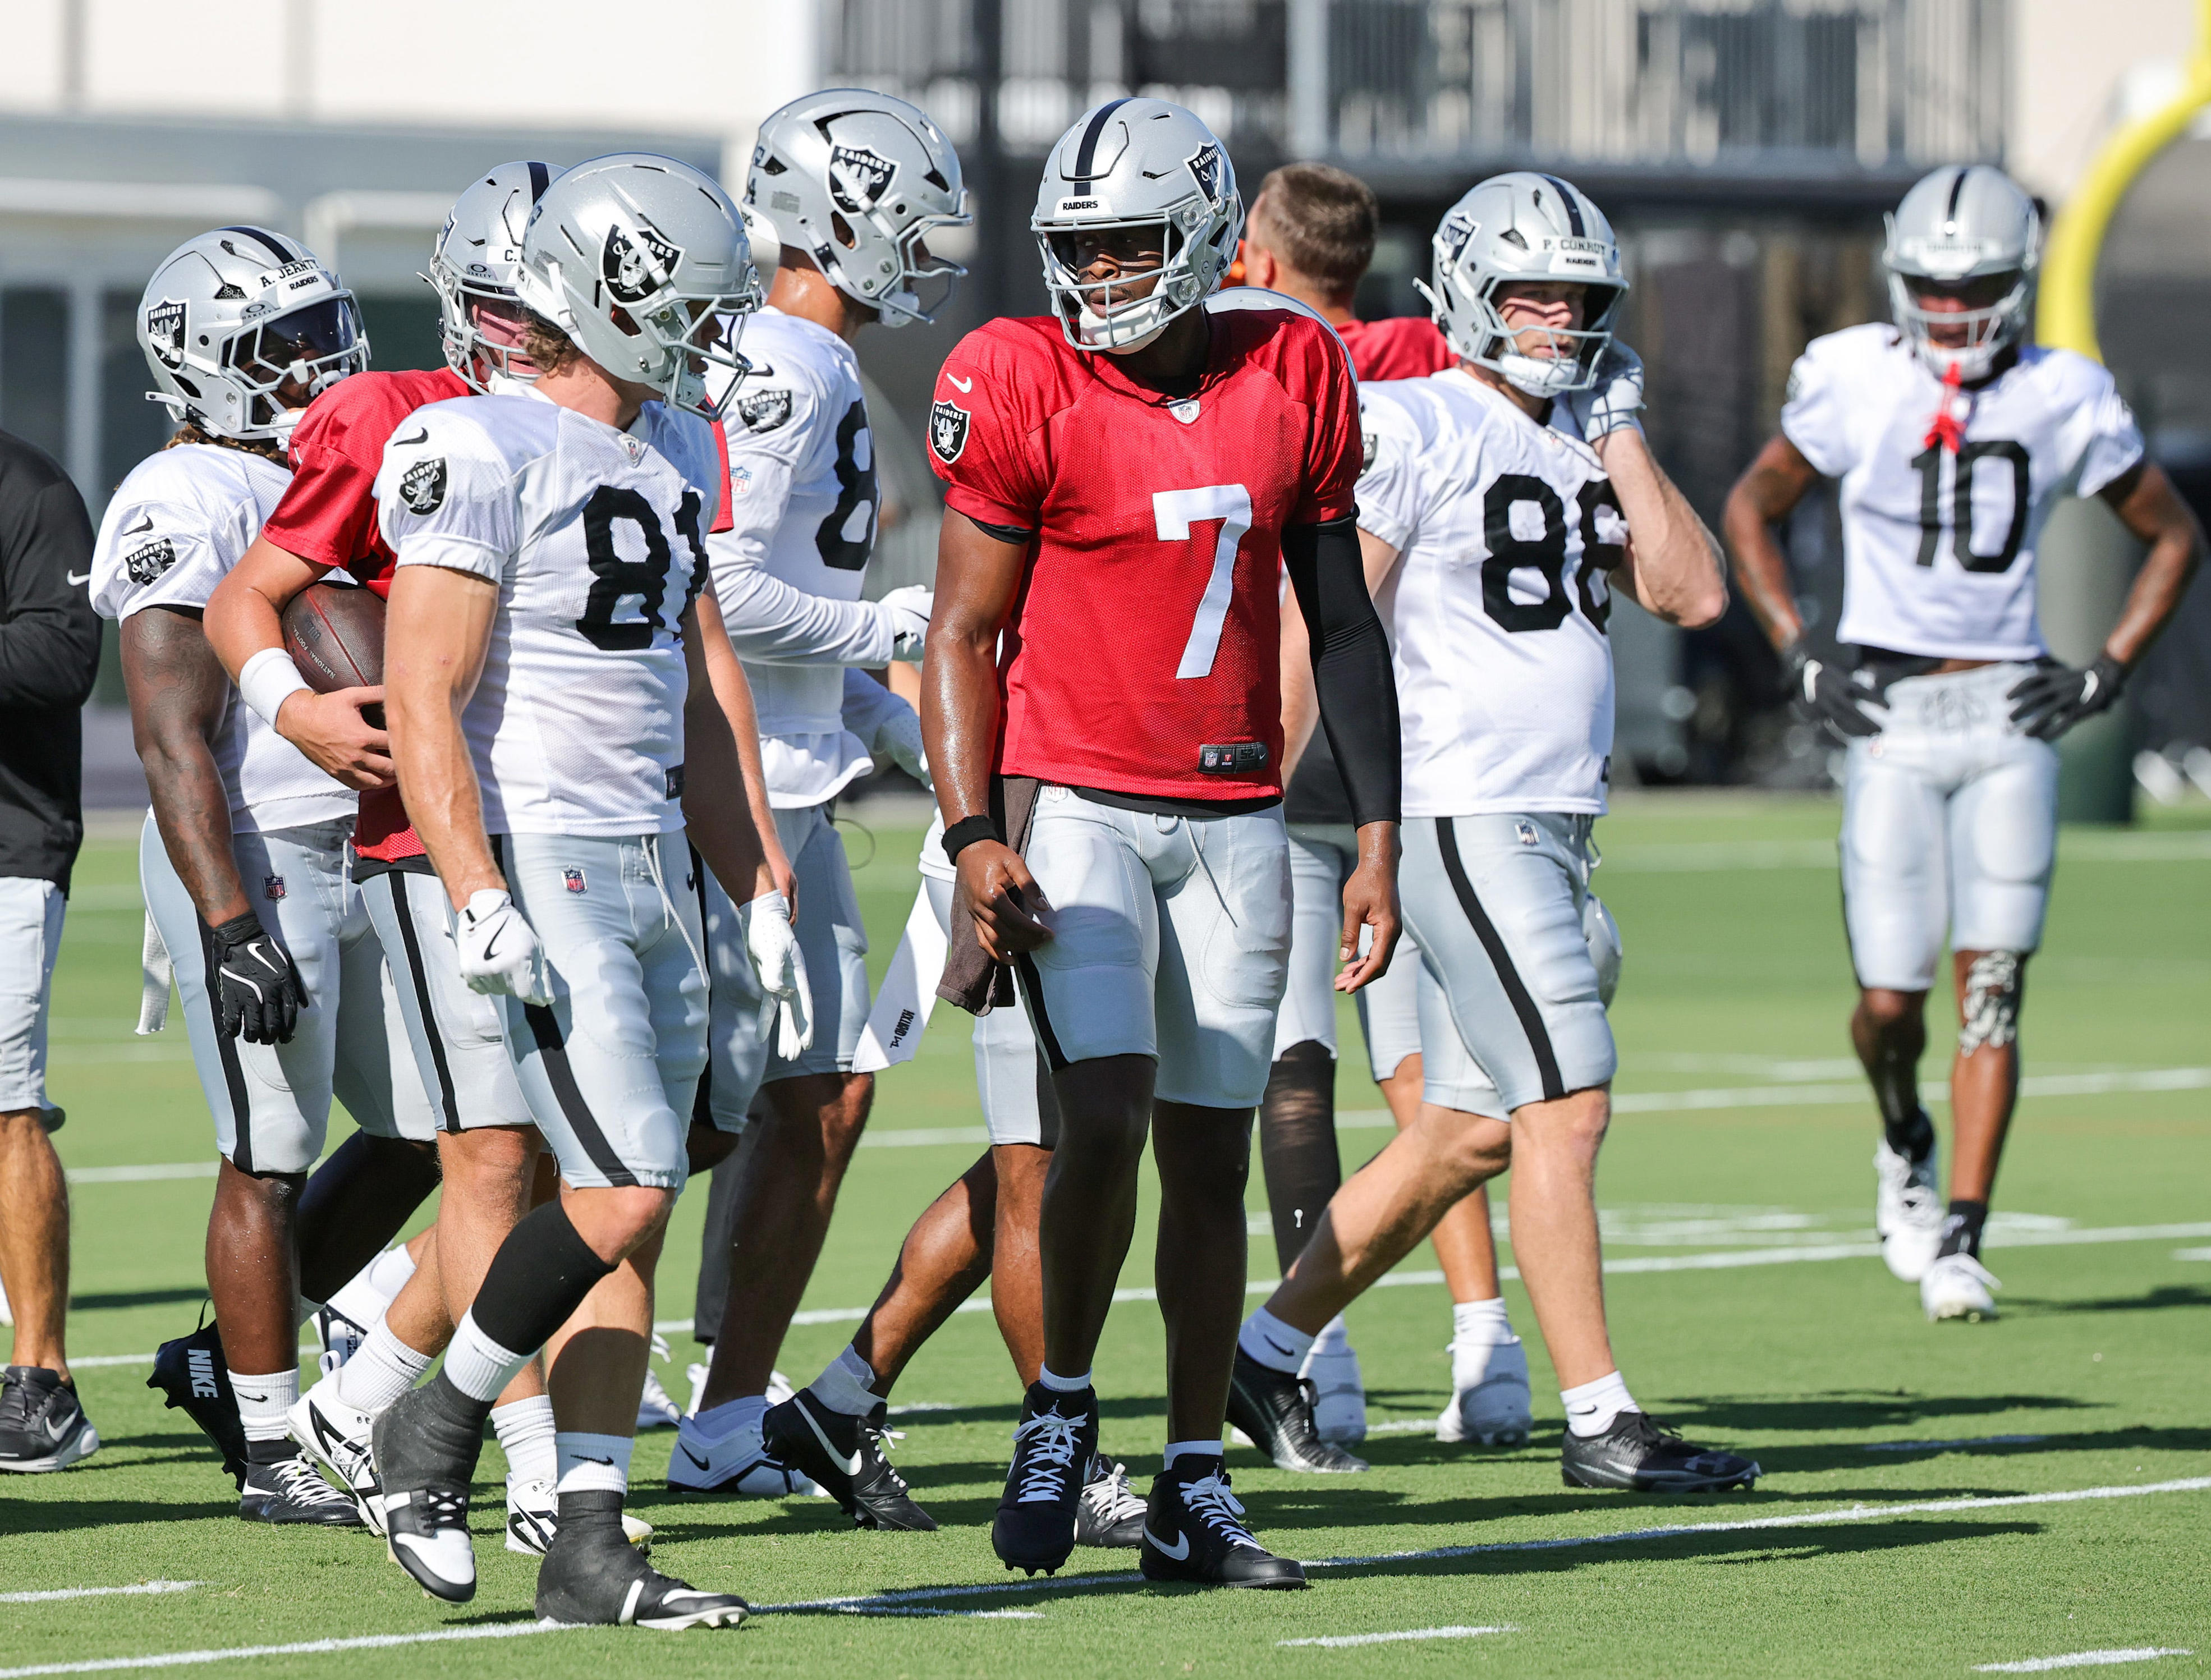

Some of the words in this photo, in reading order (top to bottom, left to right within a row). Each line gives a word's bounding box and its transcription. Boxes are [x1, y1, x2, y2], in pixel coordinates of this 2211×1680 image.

[837, 148, 891, 172] RAIDERS
[1193, 146, 1219, 169] RAIDERS
[1063, 201, 1098, 210] RAIDERS
[504, 249, 517, 261] C.
[260, 276, 275, 287] A.
[279, 259, 319, 279] JEANTY
[289, 276, 319, 290] RAIDERS
[150, 305, 182, 320] RAIDERS
[242, 310, 271, 320] OAKLEY
[741, 391, 788, 406] RAIDERS
[935, 405, 964, 420] RAIDERS
[1911, 435, 2030, 573] 10
[129, 541, 167, 563] RAIDERS
[576, 485, 708, 650] 81
[1152, 484, 1252, 679] 7
[309, 650, 336, 680] NATIONAL
[187, 1349, 219, 1398] NIKE
